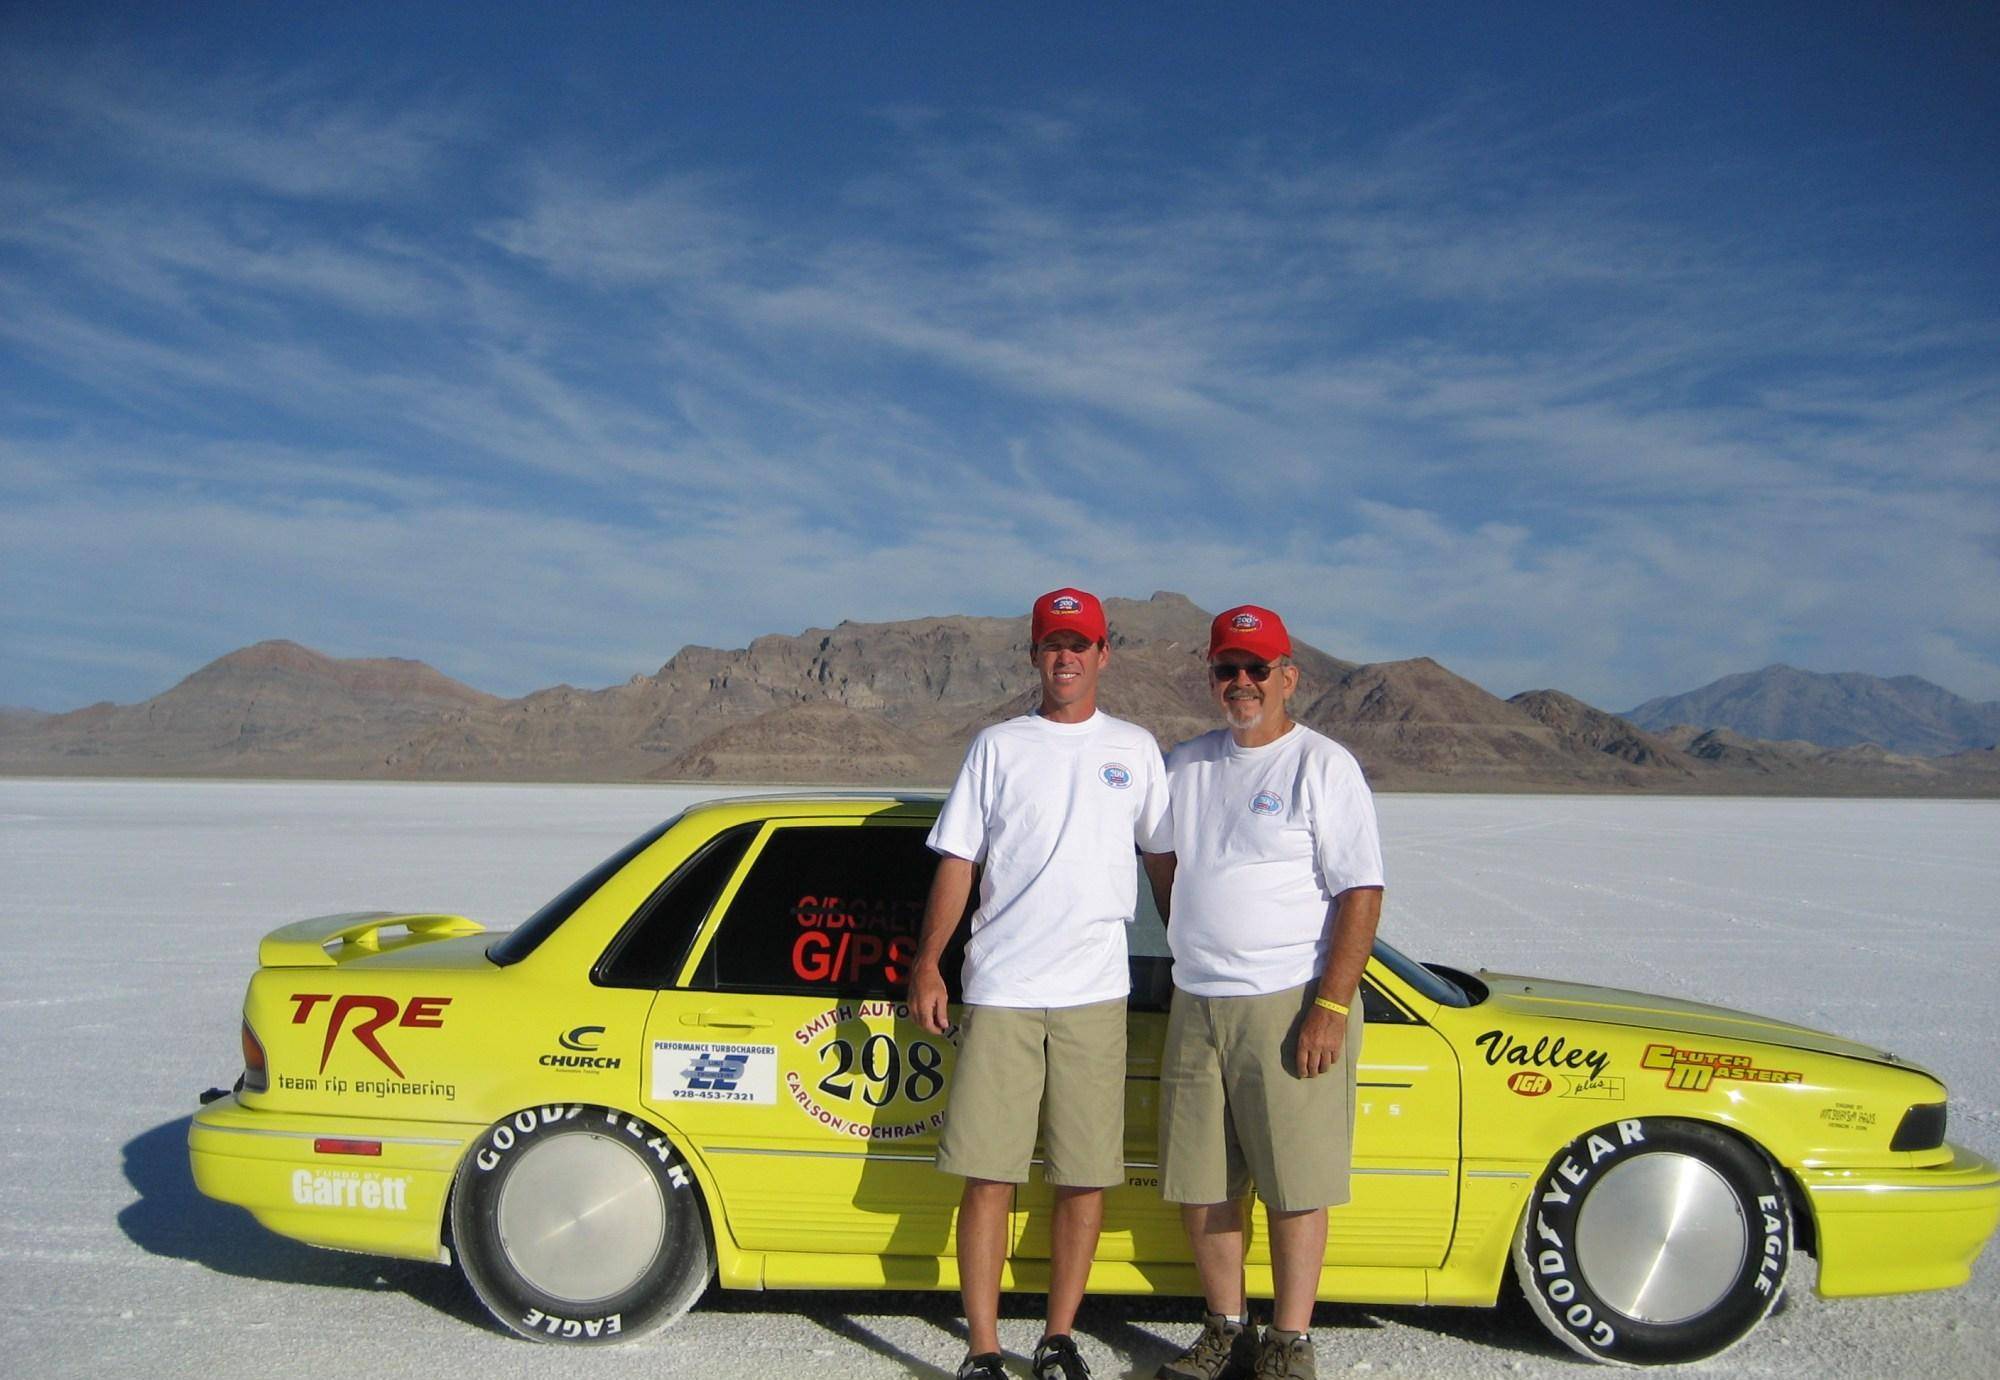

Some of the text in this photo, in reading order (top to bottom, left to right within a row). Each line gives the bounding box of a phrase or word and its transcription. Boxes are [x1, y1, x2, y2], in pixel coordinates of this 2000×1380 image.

[290, 993, 453, 1080] TRE
[795, 1002, 910, 1044] SMITH AUTO
[539, 1054, 621, 1070] CHURCH
[654, 1042, 775, 1055] PERFORMANCE TURBOCHARGERS
[1475, 1029, 1610, 1081] Valley
[1640, 1044, 1752, 1071] CLUTCH
[818, 1034, 944, 1107] 298
[1513, 1074, 1548, 1093] IGA
[1666, 1063, 1803, 1092] MASTERS
[278, 1073, 456, 1101] team rip engineering
[672, 1089, 755, 1102] 928-453-7321
[292, 1168, 408, 1210] Garrett
[1754, 1194, 1783, 1297] EAGLE
[522, 1307, 622, 1338] EAGLE
